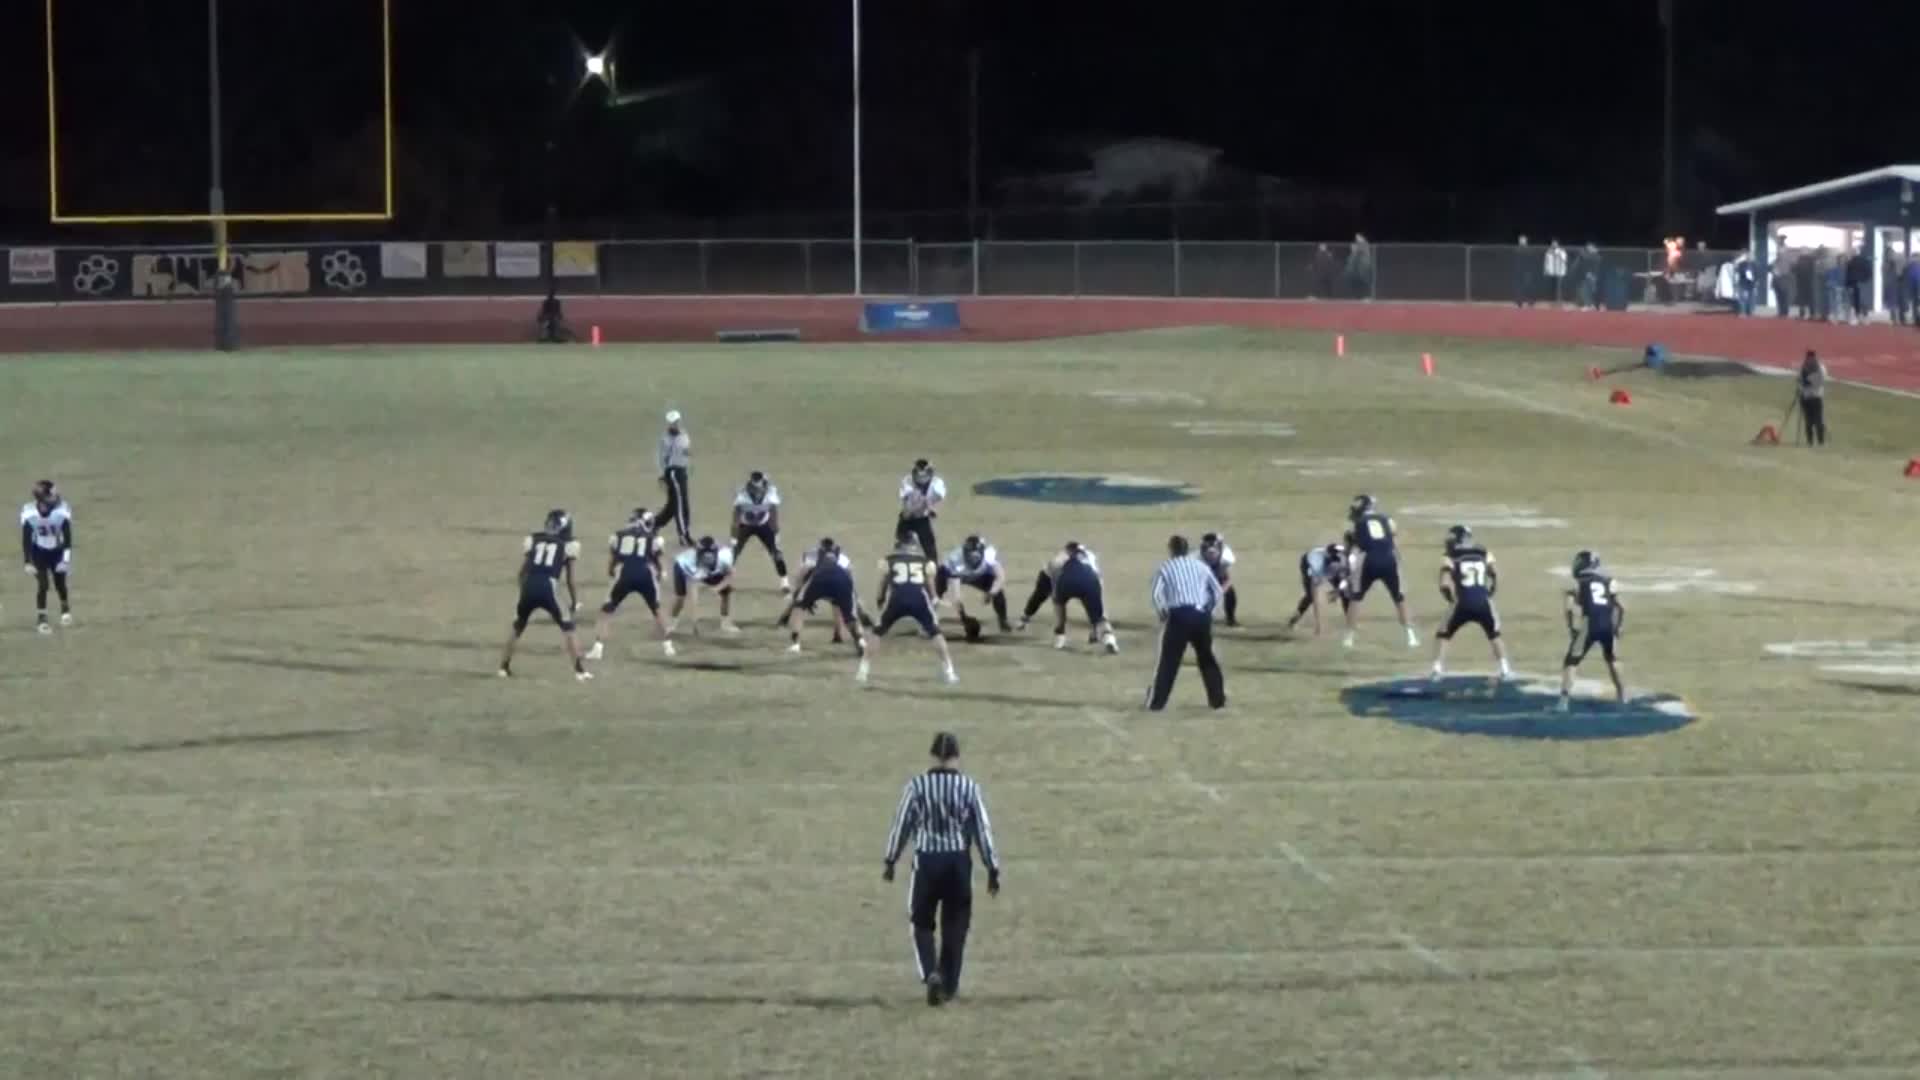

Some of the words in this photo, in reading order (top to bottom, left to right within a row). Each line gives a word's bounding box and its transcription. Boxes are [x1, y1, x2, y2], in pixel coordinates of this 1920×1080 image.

[534, 542, 557, 566] 11
[892, 562, 924, 584] 35
[1590, 582, 1608, 605] 2
